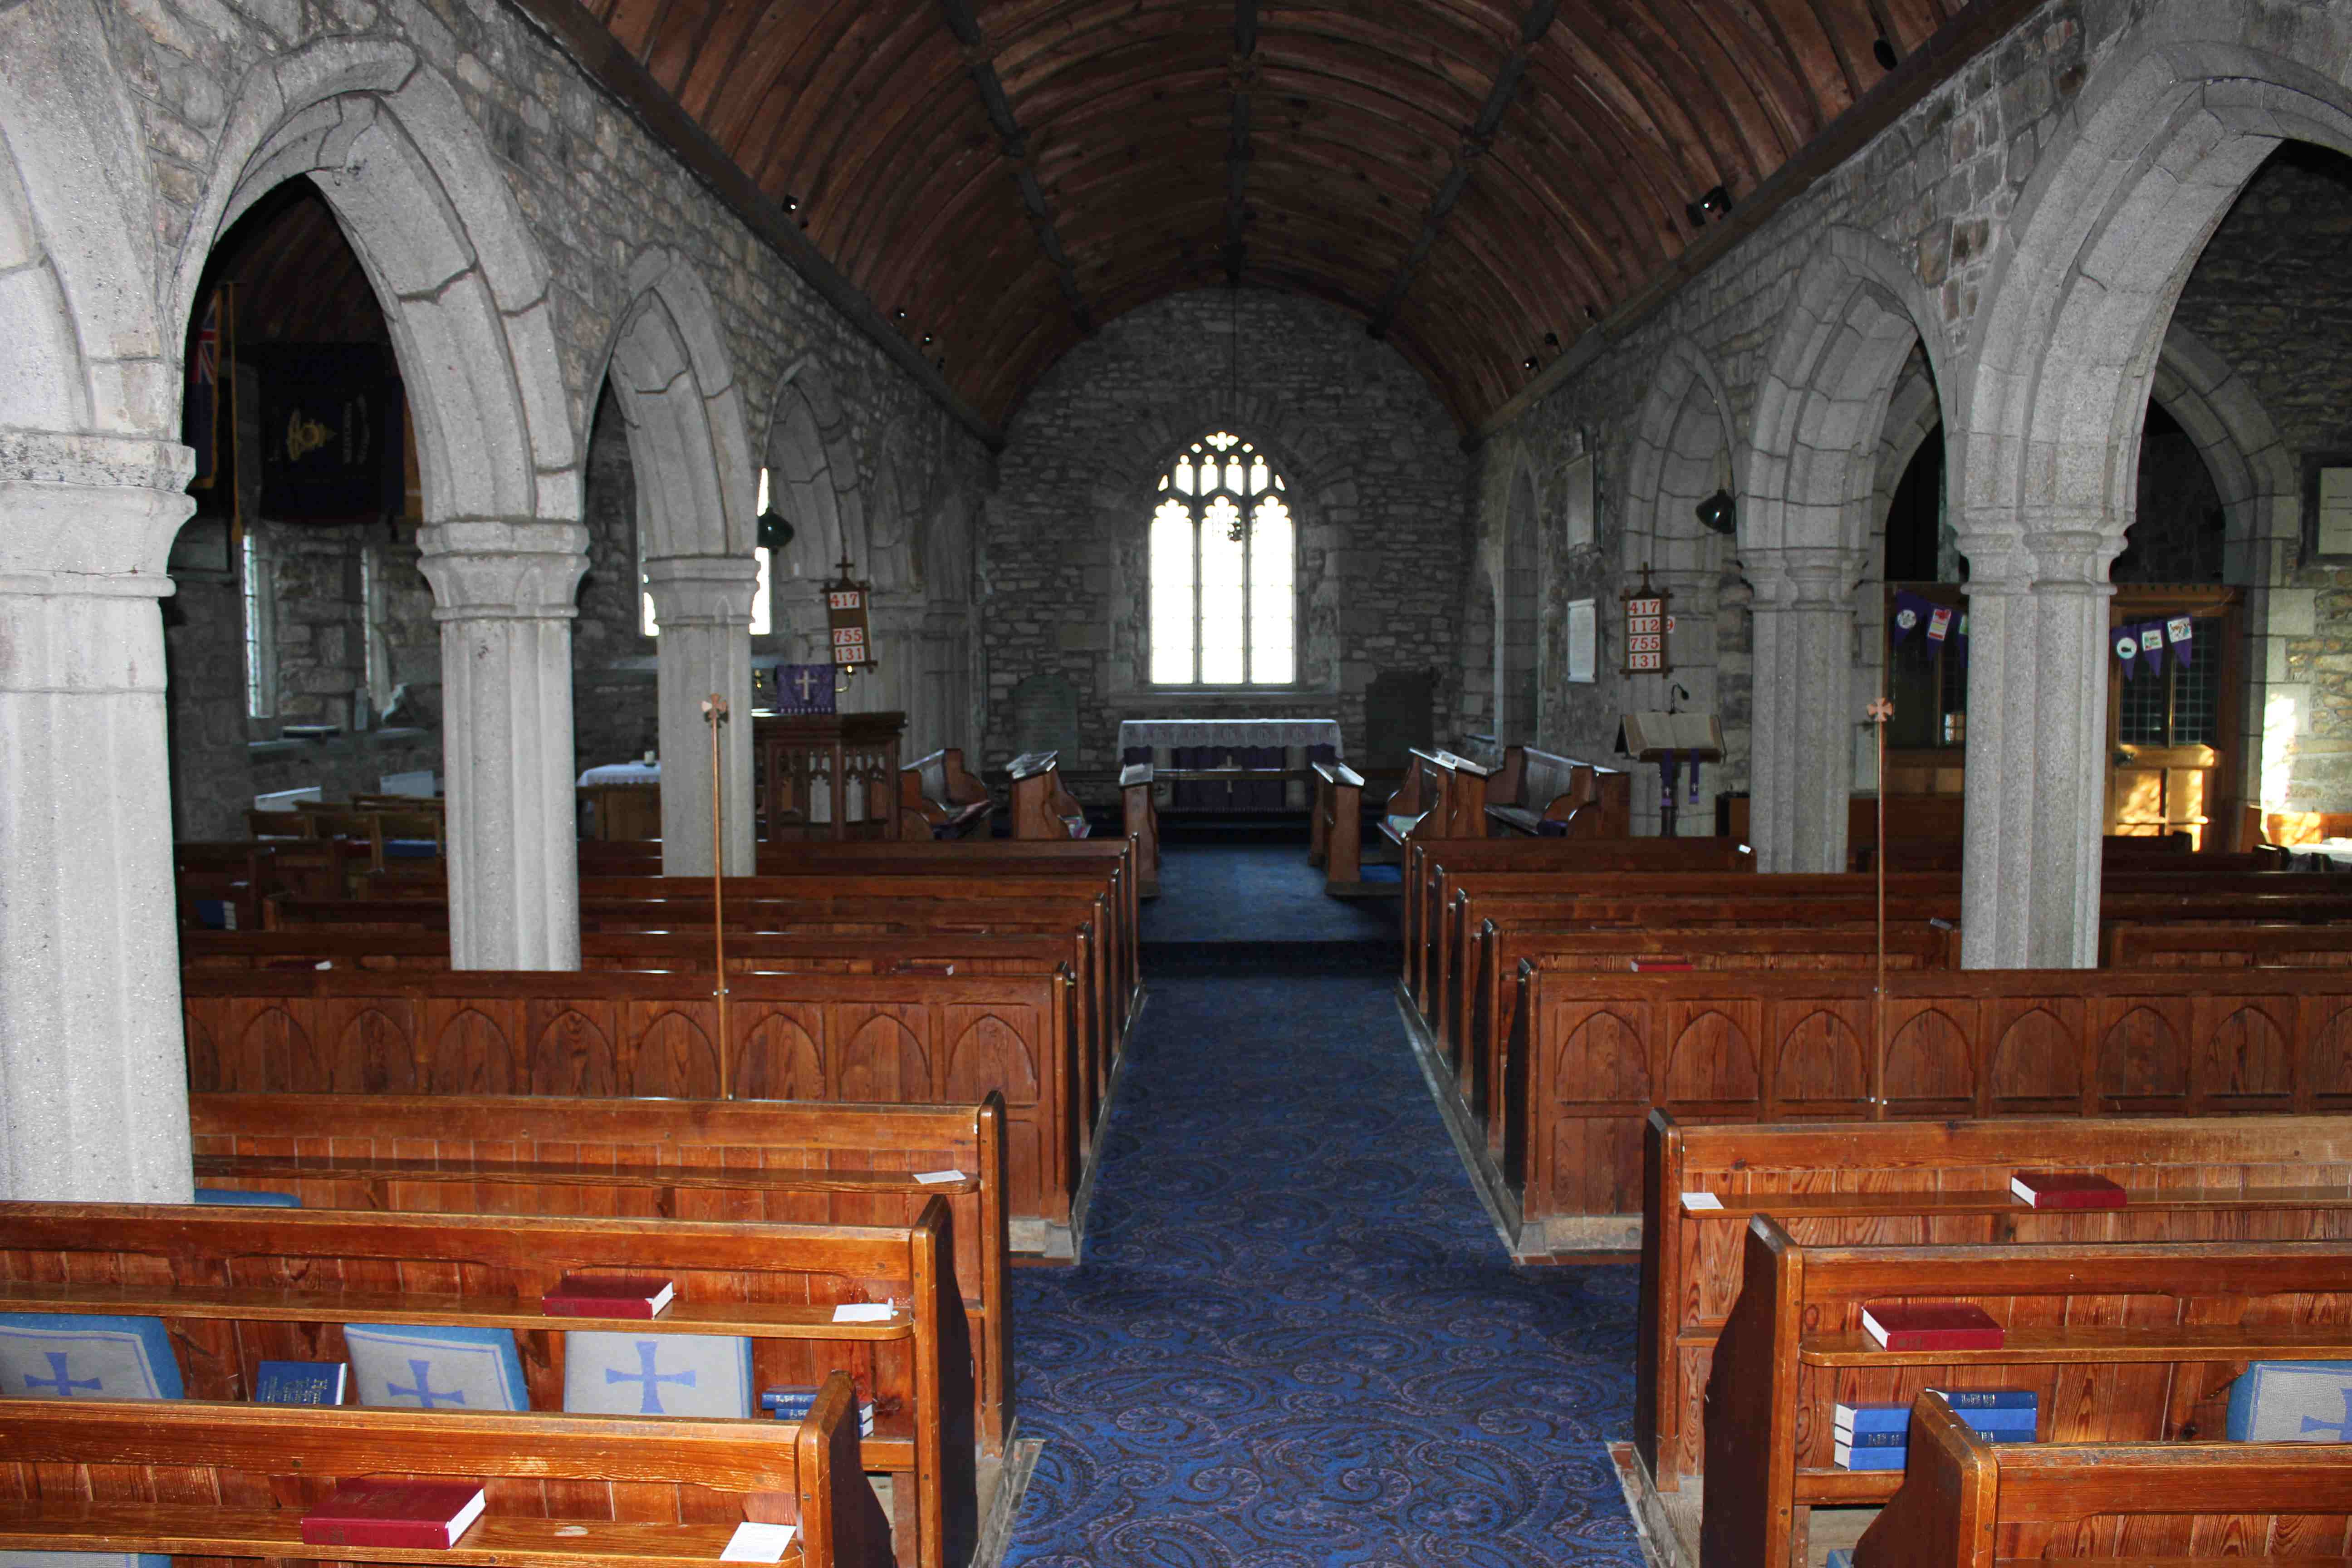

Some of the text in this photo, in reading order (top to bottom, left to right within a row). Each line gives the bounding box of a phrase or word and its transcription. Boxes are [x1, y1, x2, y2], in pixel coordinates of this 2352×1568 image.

[828, 593, 857, 607] 417
[1631, 601, 1658, 614] 417
[1632, 619, 1659, 632] 112
[835, 629, 862, 642] 755
[1631, 637, 1659, 650] 755
[838, 647, 862, 661] 131
[1632, 655, 1658, 668] 131
